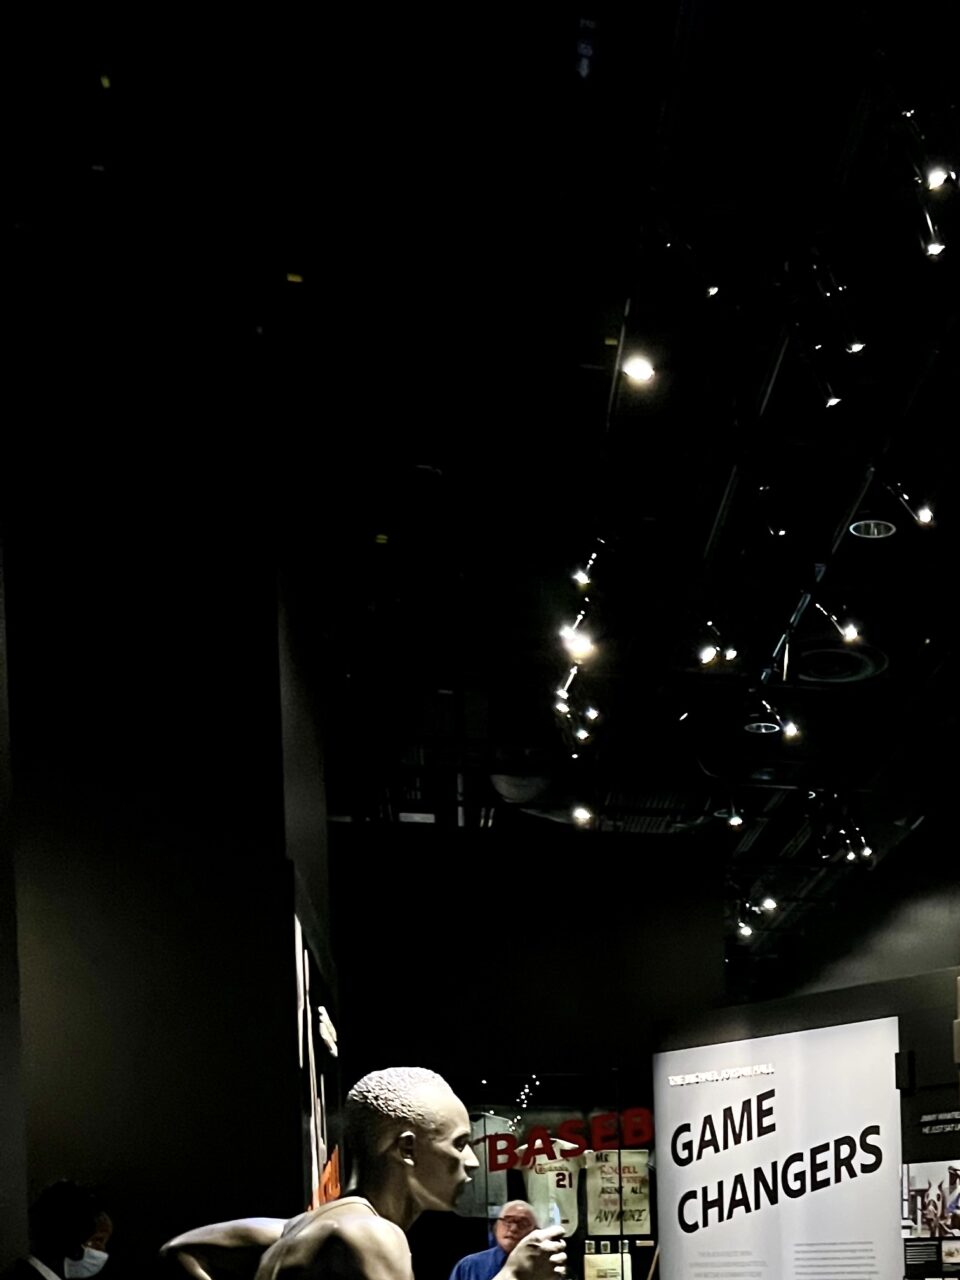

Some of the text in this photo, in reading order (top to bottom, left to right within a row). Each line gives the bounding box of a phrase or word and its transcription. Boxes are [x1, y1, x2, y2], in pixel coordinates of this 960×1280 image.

[488, 1107, 653, 1172] BASEB
[670, 1088, 776, 1167] GAME
[556, 1172, 573, 1189] 21
[677, 1125, 883, 1234] CHANGERS
